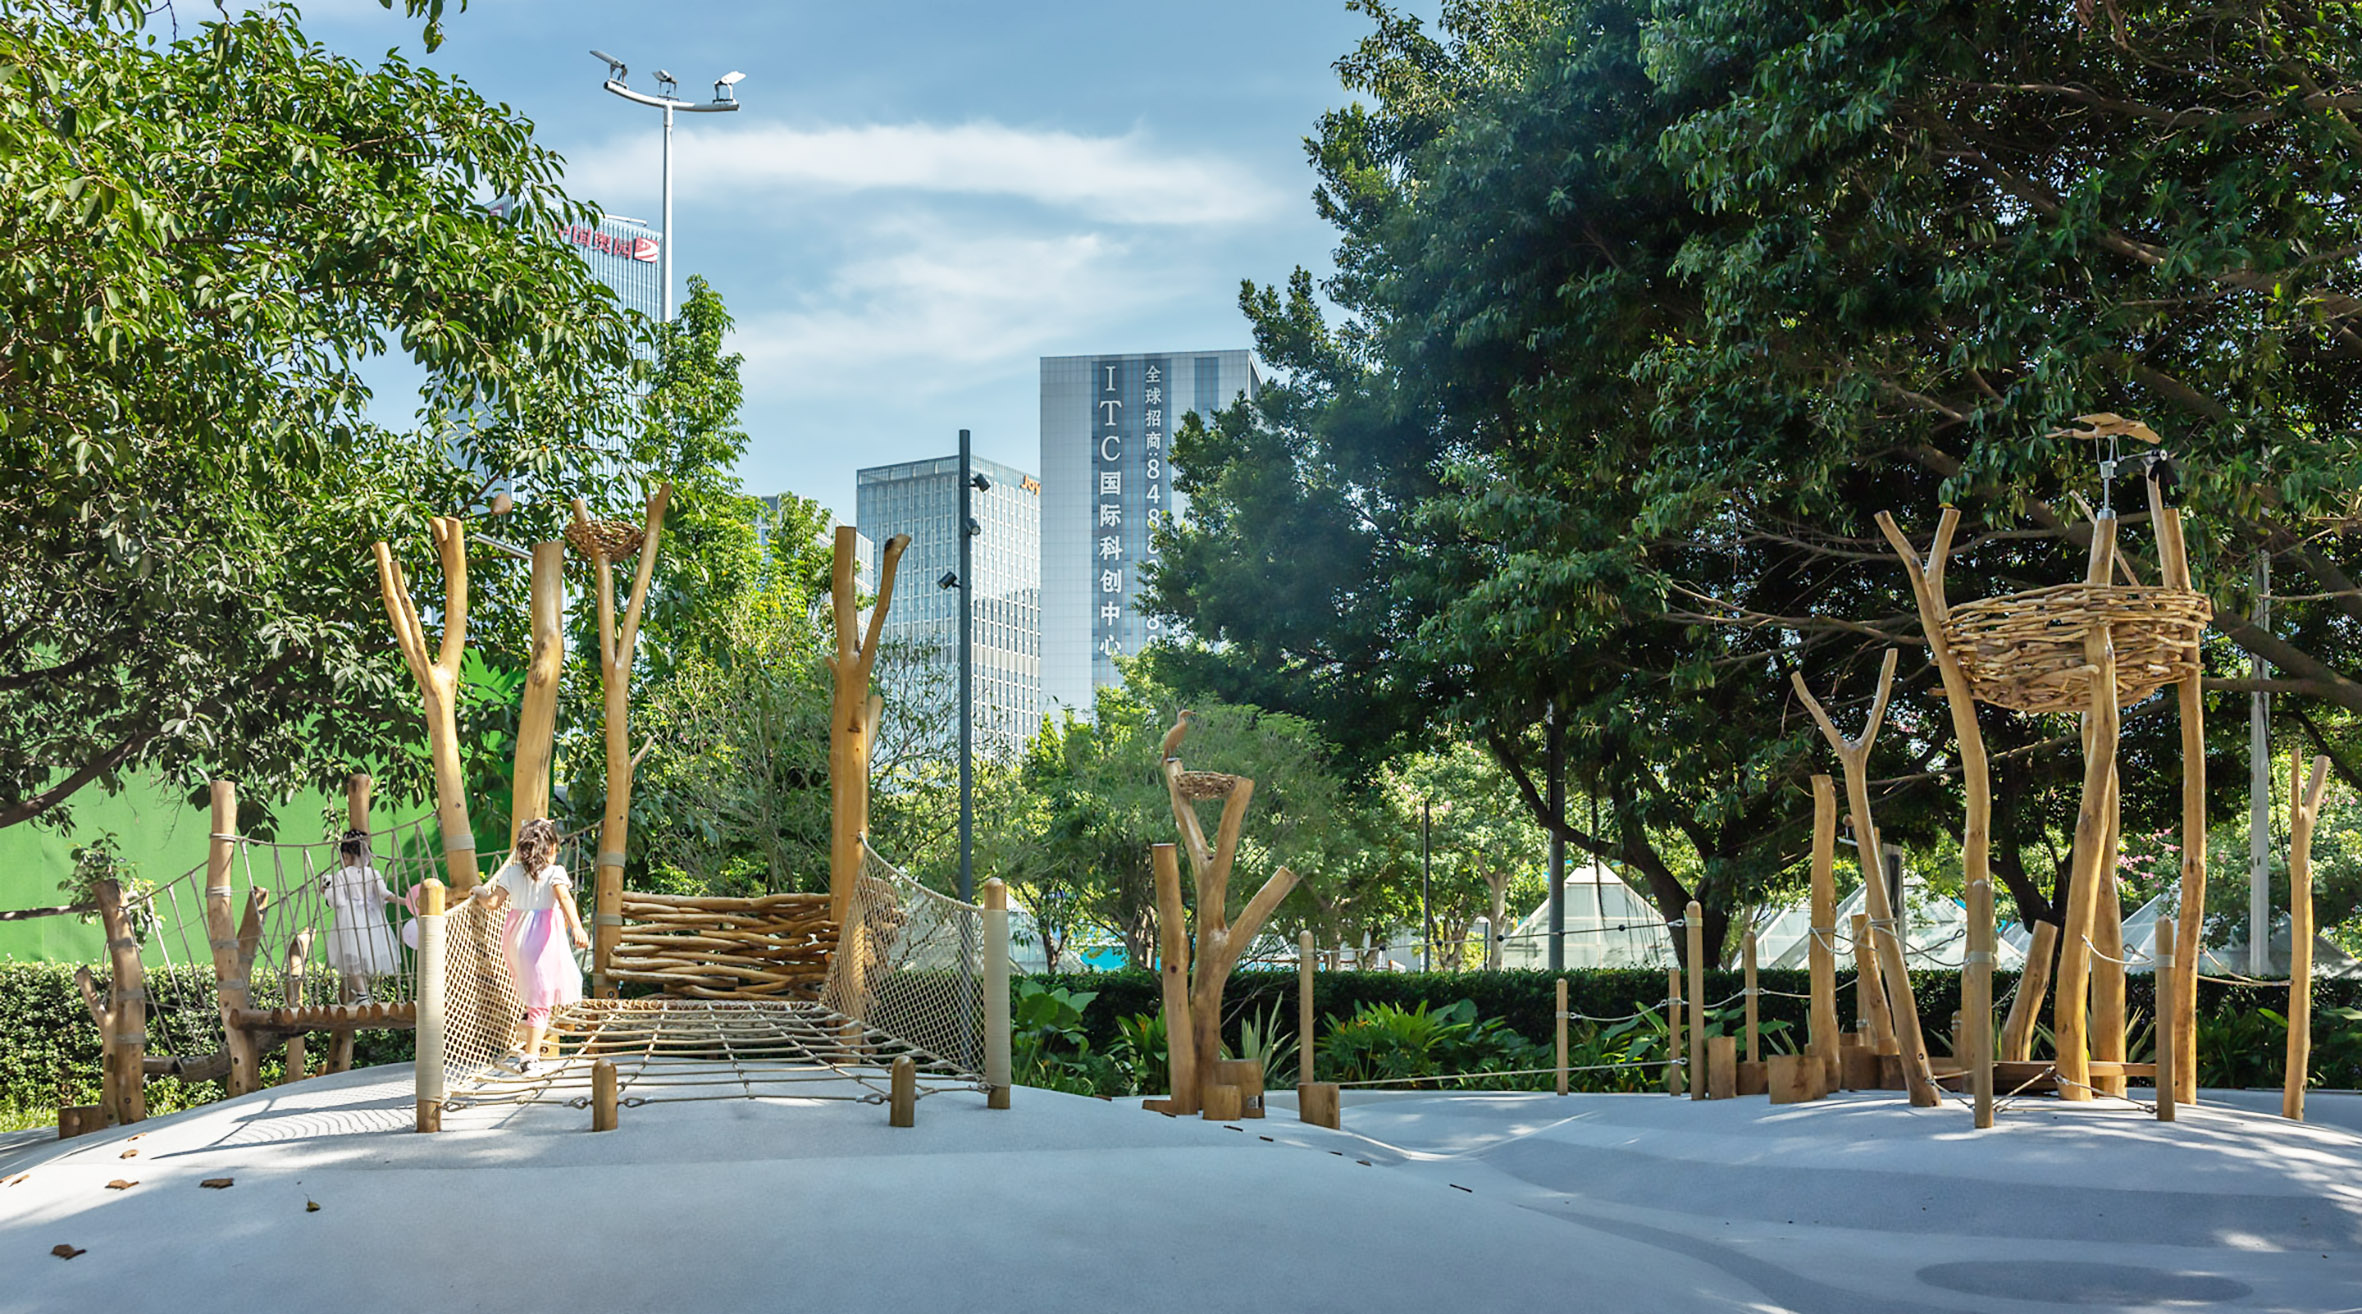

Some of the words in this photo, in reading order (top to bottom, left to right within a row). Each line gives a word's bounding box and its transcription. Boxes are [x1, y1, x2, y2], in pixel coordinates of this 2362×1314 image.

[1099, 365, 1123, 657] ITC国际科创中心
